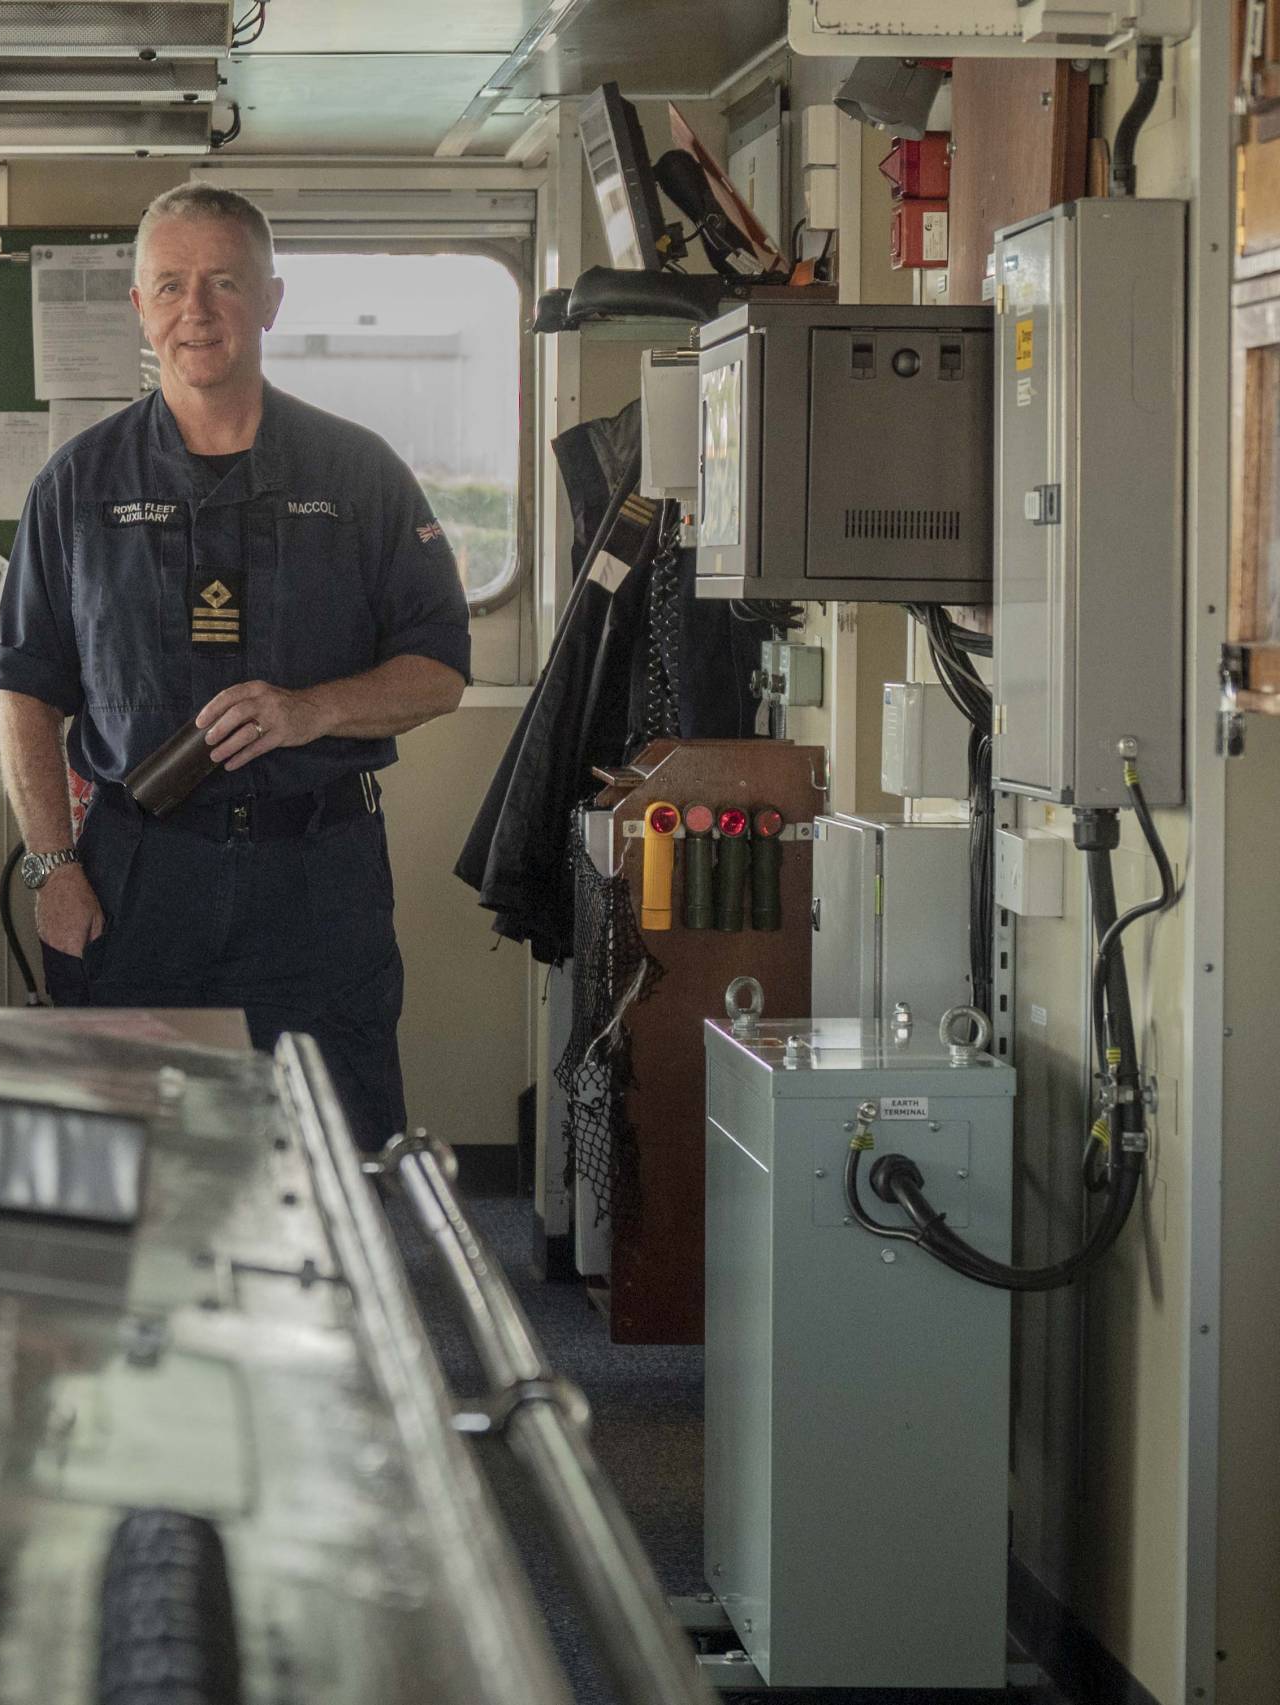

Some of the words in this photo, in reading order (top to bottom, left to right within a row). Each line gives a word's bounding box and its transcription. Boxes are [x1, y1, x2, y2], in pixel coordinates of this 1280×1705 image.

[113, 502, 142, 514] ROYAL
[145, 502, 176, 513] FLEET
[288, 501, 338, 517] MACCOLL
[120, 511, 168, 523] AUXILIARY
